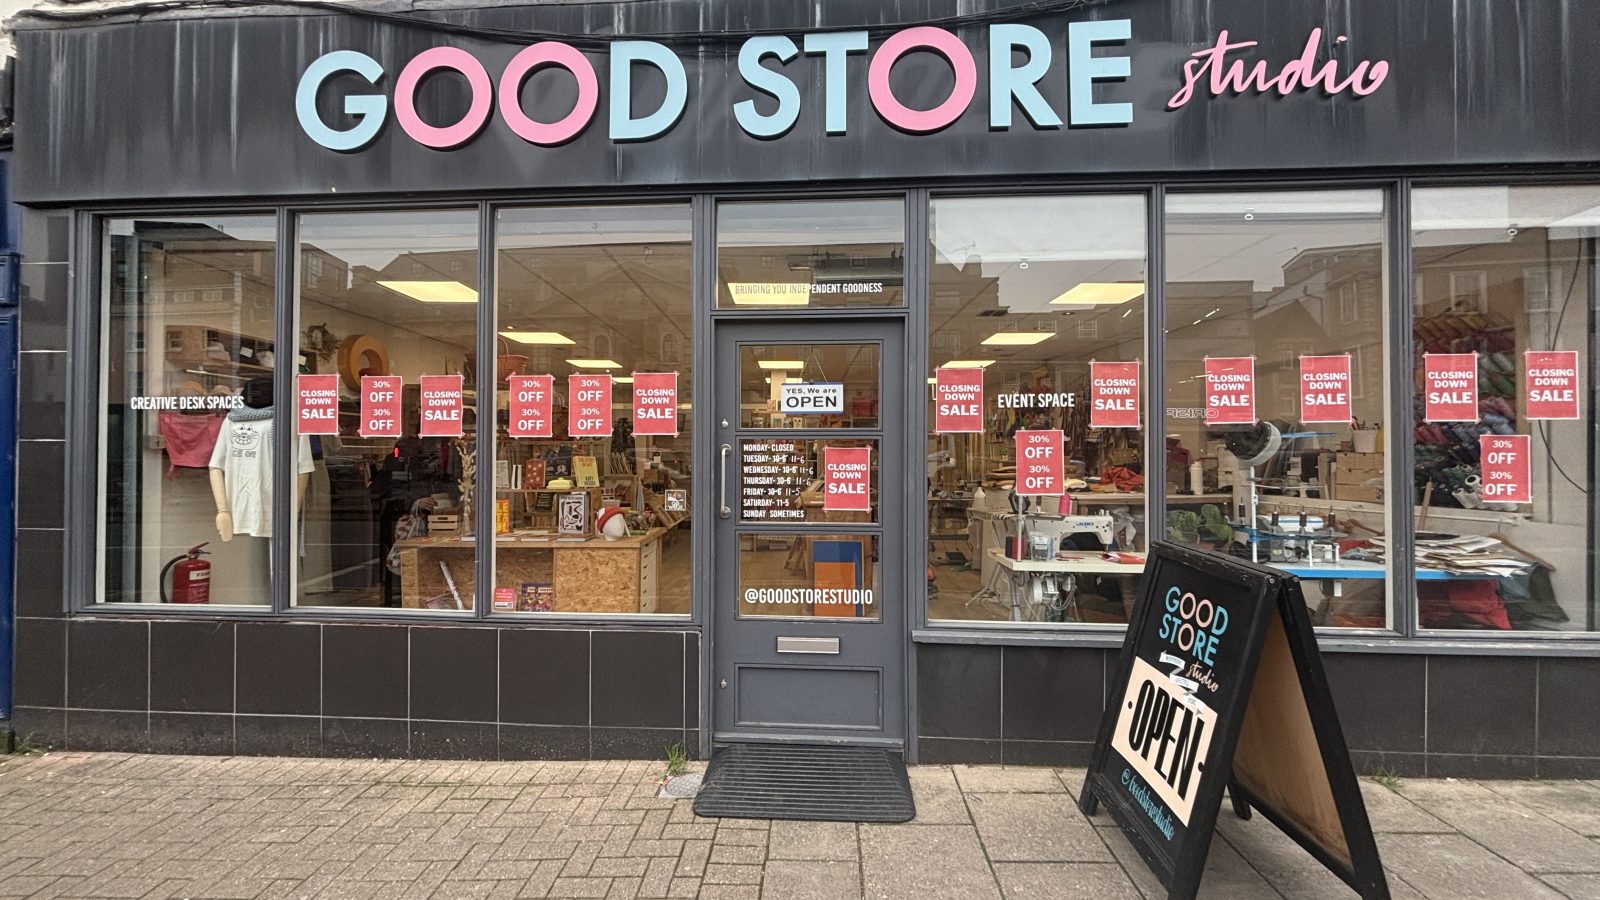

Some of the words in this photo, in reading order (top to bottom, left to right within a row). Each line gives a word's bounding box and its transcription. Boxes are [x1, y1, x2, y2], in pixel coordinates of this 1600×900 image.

[1166, 27, 1389, 112] studio
[295, 41, 688, 151] GOOD
[732, 18, 1134, 137] STORE
[735, 285, 771, 295] BRINGING
[772, 285, 787, 294] YOU
[789, 283, 841, 294] INDEPENDENT
[843, 282, 883, 293] GOODNESS
[1208, 374, 1250, 382] CLOSING
[1303, 373, 1347, 381] CLOSING
[1428, 371, 1473, 379] CLOSING
[1214, 383, 1244, 391] DOWN
[1434, 380, 1467, 388] DOWN
[369, 392, 394, 402] OFF
[518, 392, 544, 402] OFF
[578, 391, 603, 401] OFF
[997, 393, 1035, 408] EVENT
[1037, 392, 1075, 408] SPACE
[1210, 395, 1249, 406] SALE
[1305, 394, 1346, 405] SALE
[1429, 392, 1472, 404] SALE
[1530, 390, 1573, 401] SALE
[131, 396, 177, 410] CREATIVE
[179, 396, 206, 410] DESK
[207, 395, 245, 409] SPACES
[786, 396, 837, 407] OPEN
[1095, 399, 1135, 410] SALE
[302, 409, 335, 419] SALE
[425, 410, 459, 420] SALE
[581, 408, 600, 416] 30%
[637, 408, 673, 418] SALE
[940, 405, 979, 415] SALE
[369, 420, 394, 430] OFF
[518, 420, 544, 430] OFF
[578, 419, 603, 430] OFF
[1025, 447, 1054, 458] OFF
[1488, 452, 1516, 464] OFF
[828, 483, 866, 493] SALE
[1026, 477, 1054, 488] OFF
[1485, 484, 1517, 495] OFF
[769, 510, 804, 518] SOMETIMES
[744, 588, 873, 605] @GOODSTORESTUDIO
[1166, 586, 1229, 636] GOOD
[1159, 614, 1219, 667] STORE
[1186, 661, 1219, 692] studio
[1128, 679, 1205, 802] OPEN
